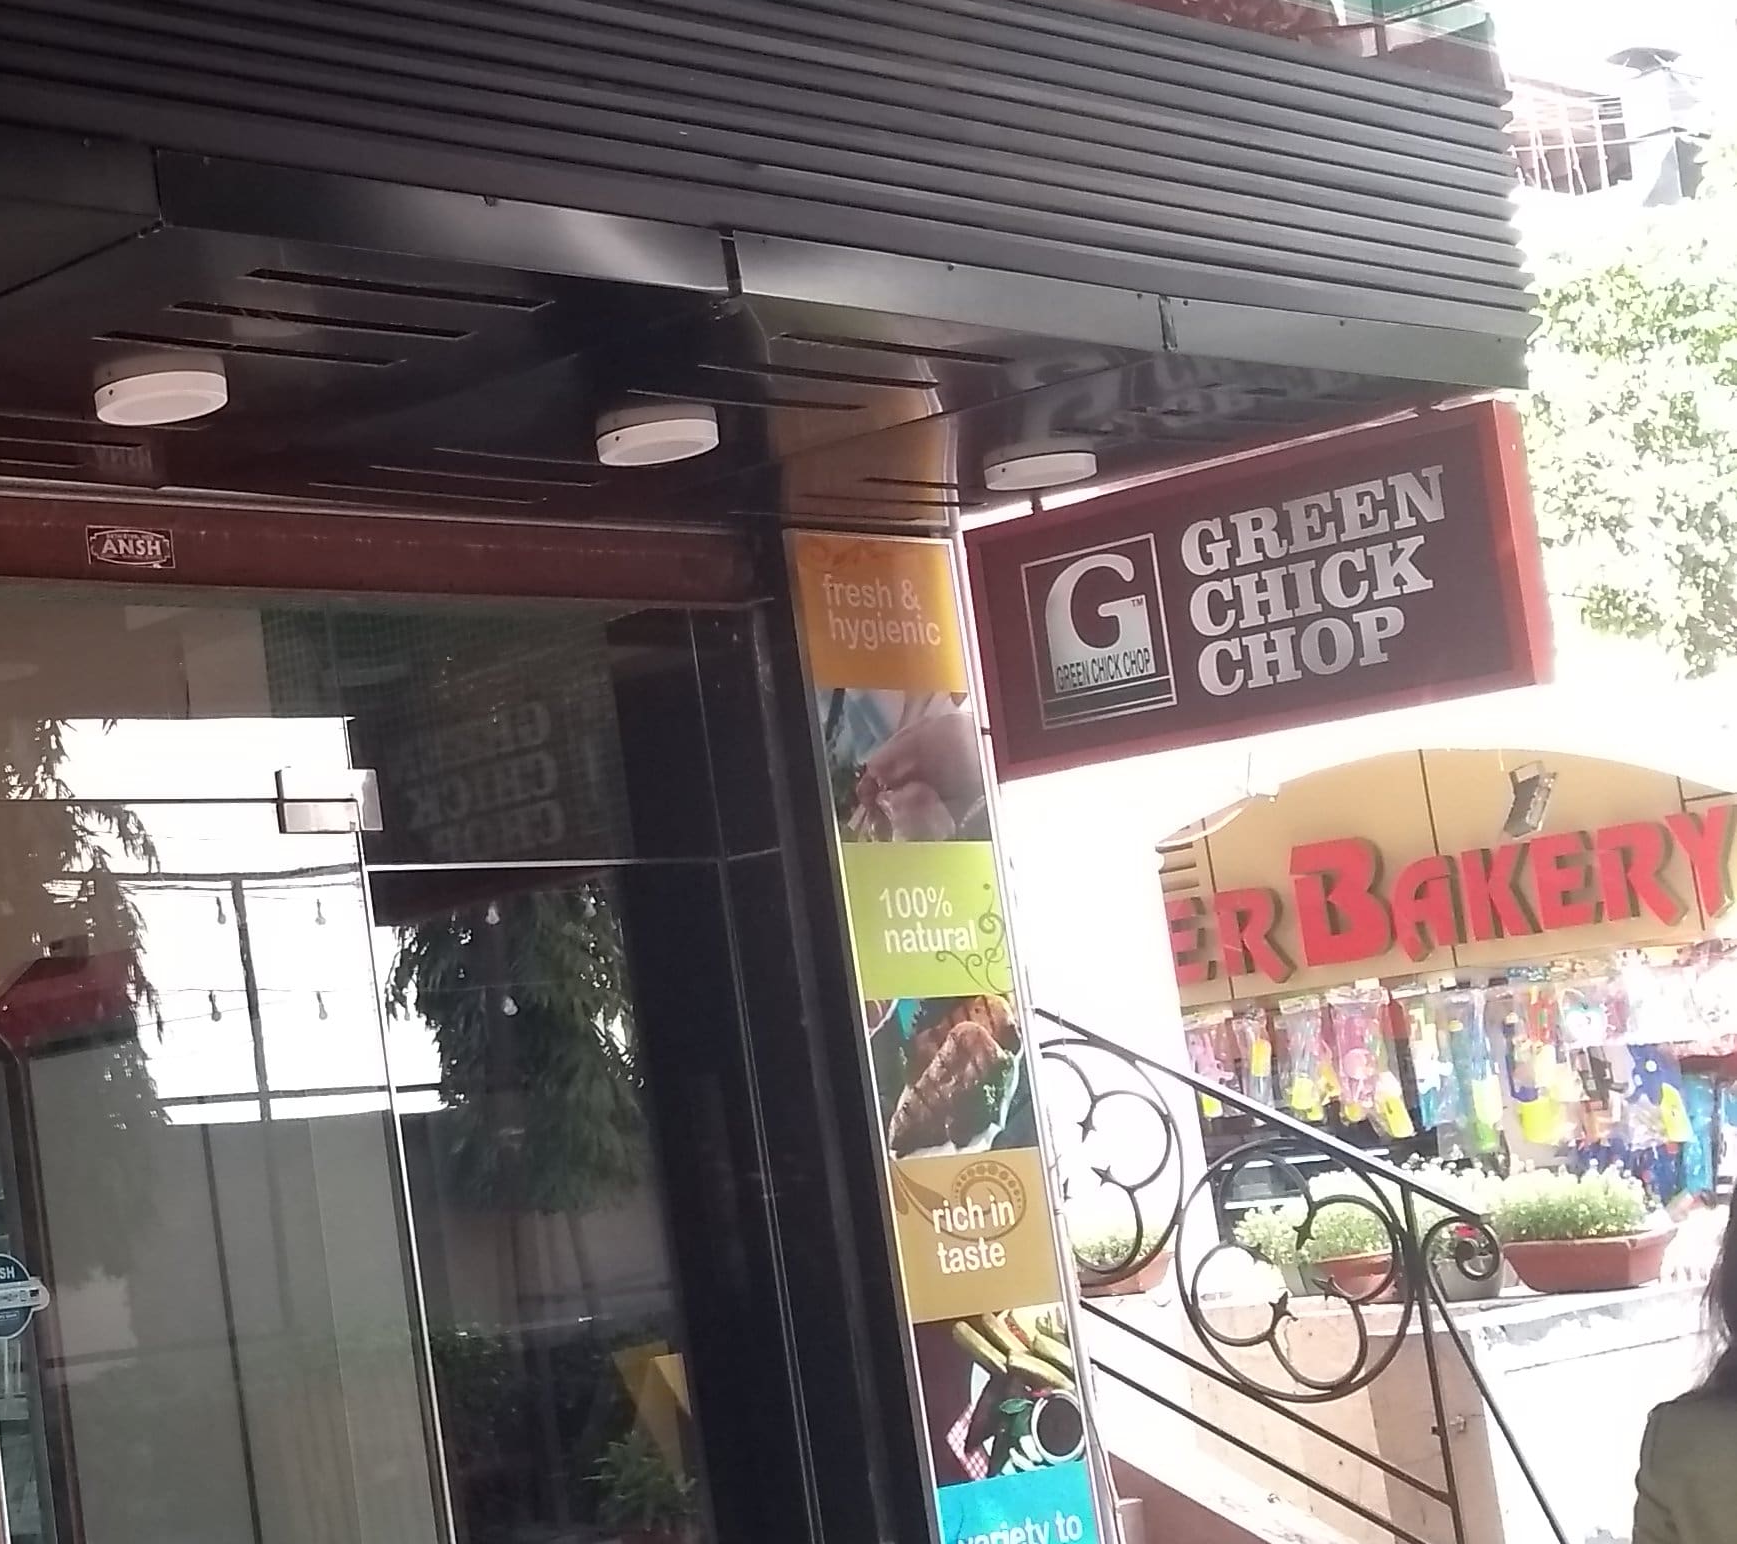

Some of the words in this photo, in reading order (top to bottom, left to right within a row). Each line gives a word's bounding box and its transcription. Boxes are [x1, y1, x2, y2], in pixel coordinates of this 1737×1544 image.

[1180, 463, 1449, 579] GREEN
[102, 539, 161, 555] ANSH
[822, 573, 895, 612] fresh
[899, 577, 922, 611] &
[1131, 598, 1143, 607] TM
[1189, 534, 1435, 639] CHICK
[827, 606, 942, 650] hygienic
[1046, 554, 1156, 693] G
[1056, 661, 1089, 690] GREEN
[1092, 654, 1122, 682] CHICK
[1123, 648, 1150, 675] CHOP
[1196, 606, 1407, 698] CHOP
[879, 885, 953, 919] 100%
[884, 918, 979, 956] natural
[932, 1196, 984, 1235] rich
[987, 1194, 1016, 1228] in
[936, 1237, 1006, 1274] taste
[1053, 1512, 1084, 1544] to
